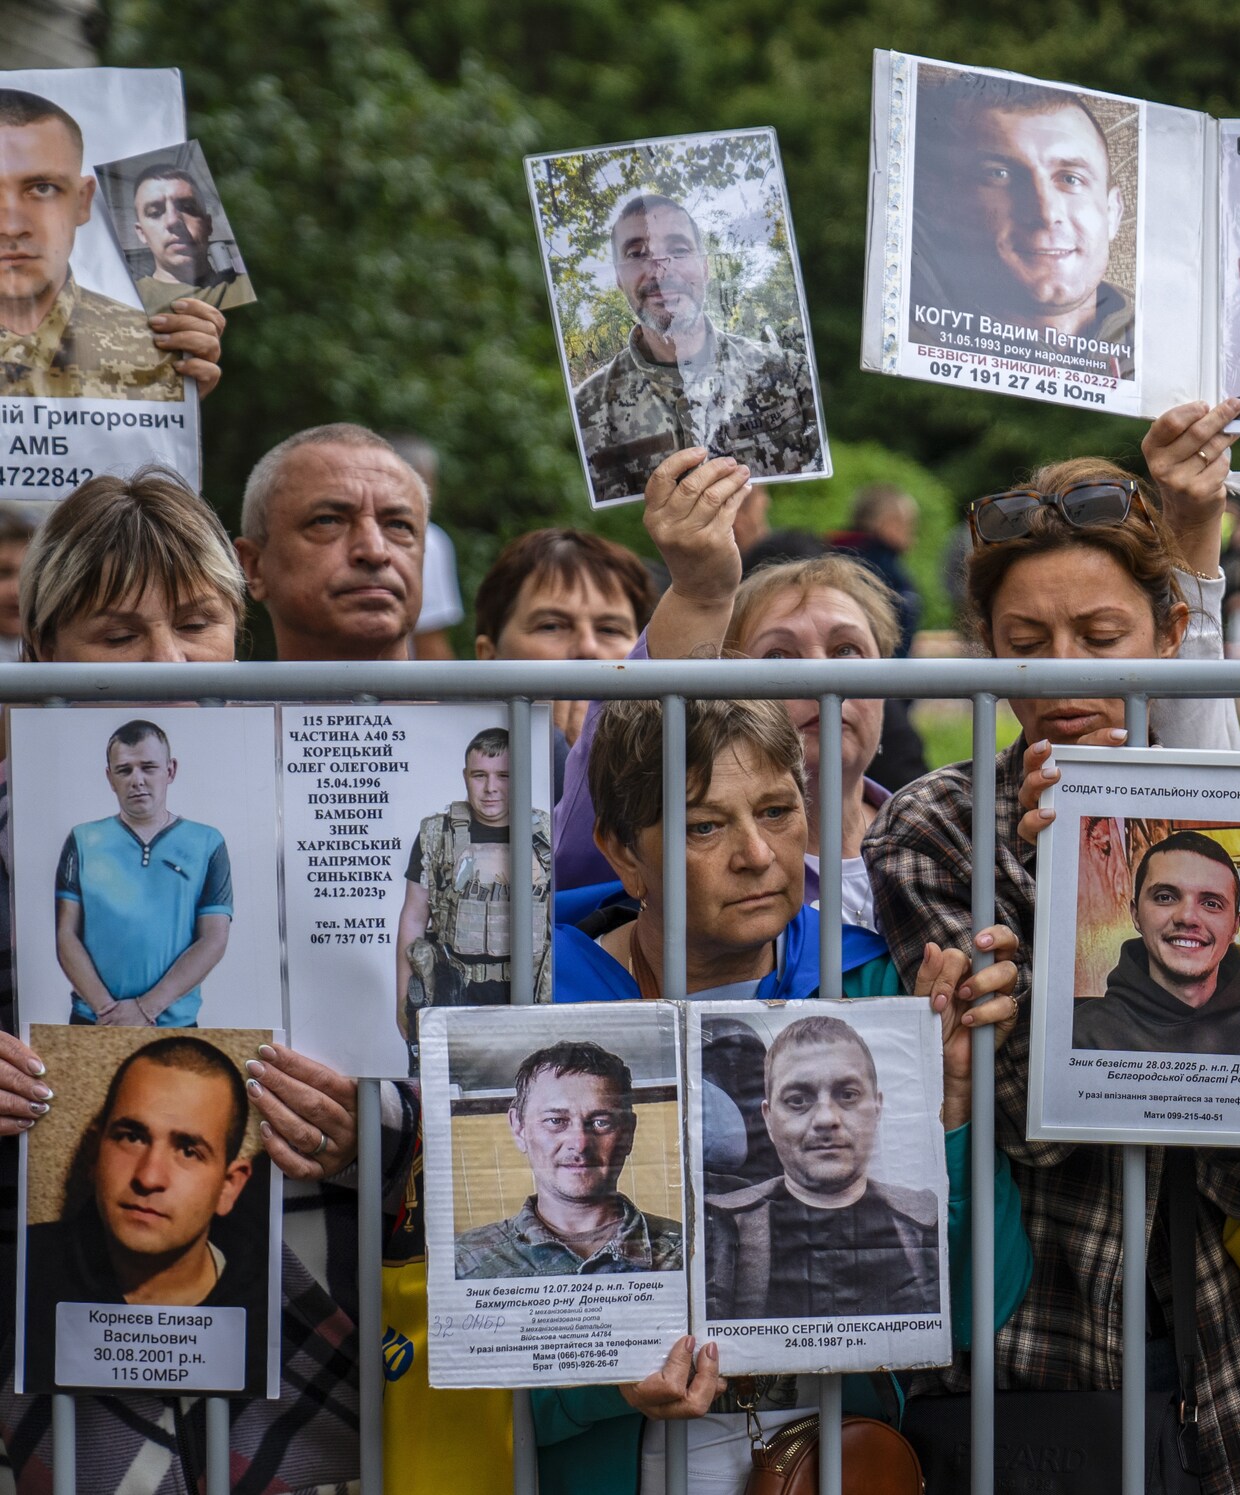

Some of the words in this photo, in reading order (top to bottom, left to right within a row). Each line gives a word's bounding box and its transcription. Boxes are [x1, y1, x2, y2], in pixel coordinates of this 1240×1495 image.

[914, 304, 974, 330] КОГУТ
[979, 315, 1039, 342] Вадим
[1045, 327, 1132, 359] Петрович
[940, 331, 1001, 351] 31.05.1993
[1004, 343, 1031, 358] року
[1034, 349, 1107, 370] народження
[917, 345, 987, 366] БЕЗВІСТИ
[1065, 370, 1117, 389] 26.02.22
[929, 360, 963, 379] 097
[970, 367, 1000, 386] 191
[1008, 374, 1030, 390] 27
[1035, 379, 1057, 395] 45
[1063, 383, 1105, 404] Юля
[33, 405, 185, 431] Григорович
[9, 435, 69, 456] АМБ
[302, 715, 323, 726] 115
[327, 715, 393, 727] БРИГАДА
[289, 731, 360, 742] ЧАСТИНА
[364, 731, 388, 741] А40
[392, 731, 406, 741] 53
[303, 744, 393, 758] КОРЕЦЬКИЙ
[287, 762, 326, 773] ОЛЕГ
[330, 761, 409, 773] ОЛЕГОВИЧ
[317, 777, 381, 788] 15.04.1996
[308, 791, 389, 804] ПОЗИВНИЙ
[1061, 784, 1103, 795] СОЛДАТ
[1105, 786, 1128, 795] 9-ГО
[1130, 787, 1199, 798] БАТАЛЬЙОНУ
[314, 808, 383, 820] БАМБОНІ
[329, 824, 369, 835] ЗНИК
[297, 837, 402, 851] ХАРКІВСЬКИЙ
[308, 855, 391, 867] НАПРЯМОК
[307, 871, 392, 882] СИНЬКІВКА
[314, 887, 386, 899] 24.12.2023р
[315, 920, 340, 929] тел.
[344, 918, 385, 929] МАТИ
[310, 934, 331, 944] 067
[335, 934, 356, 944] 737
[360, 934, 373, 943] 07
[378, 933, 391, 943] 51
[1068, 1057, 1094, 1067] Зник
[1096, 1058, 1143, 1069] безвісти
[1146, 1060, 1197, 1071] 28.03.2025
[1199, 1063, 1208, 1072] р.
[1211, 1064, 1229, 1072] н.п.
[1107, 1071, 1184, 1083] Бєлгородської
[1186, 1073, 1228, 1084] області
[1078, 1090, 1085, 1099] У
[1085, 1092, 1103, 1101] разі
[1104, 1092, 1147, 1101] впізнання
[1149, 1093, 1202, 1103] звертайтеся
[1143, 1111, 1165, 1119] Мати
[1167, 1112, 1223, 1121] 099-215-40-51
[466, 1287, 491, 1297] Зник
[493, 1285, 540, 1296] безвісти
[543, 1283, 593, 1293] 12.07.2024
[595, 1284, 605, 1293] р.
[607, 1283, 625, 1292] н.п.
[628, 1281, 664, 1291] Торець
[475, 1297, 550, 1309] Бахмутського
[553, 1297, 574, 1306] р-ну
[579, 1292, 632, 1305] Донецької
[634, 1292, 655, 1302] обл.
[535, 1307, 582, 1315] механізований
[89, 1310, 153, 1326] Корнєєв
[158, 1312, 213, 1329] Елизар
[537, 1315, 582, 1324] механізована
[525, 1324, 574, 1332] механізований
[707, 1324, 789, 1337] ПРОХОРЕНКО
[792, 1321, 834, 1334] СЕРГІЙ
[837, 1320, 943, 1334] ОЛЕКСАНДРОВИЧ
[104, 1330, 197, 1345] Васильович
[520, 1333, 557, 1341] Військова
[785, 1337, 842, 1348] 24.08.1987
[846, 1338, 867, 1348] р.н.
[469, 1346, 476, 1354] У
[477, 1343, 494, 1354] разі
[495, 1342, 539, 1352] впізнання
[540, 1340, 593, 1350] звертайтеся
[606, 1337, 662, 1349] телефонами:
[94, 1347, 173, 1363] 30.08.2001
[179, 1352, 206, 1366] р.н.
[532, 1352, 556, 1361] Мама
[557, 1349, 618, 1360] (066)-676-96-09
[532, 1362, 553, 1371] Брат
[558, 1359, 619, 1370] (095)-926-26-67
[112, 1367, 138, 1380] 115
[142, 1368, 189, 1382] ОМБР
